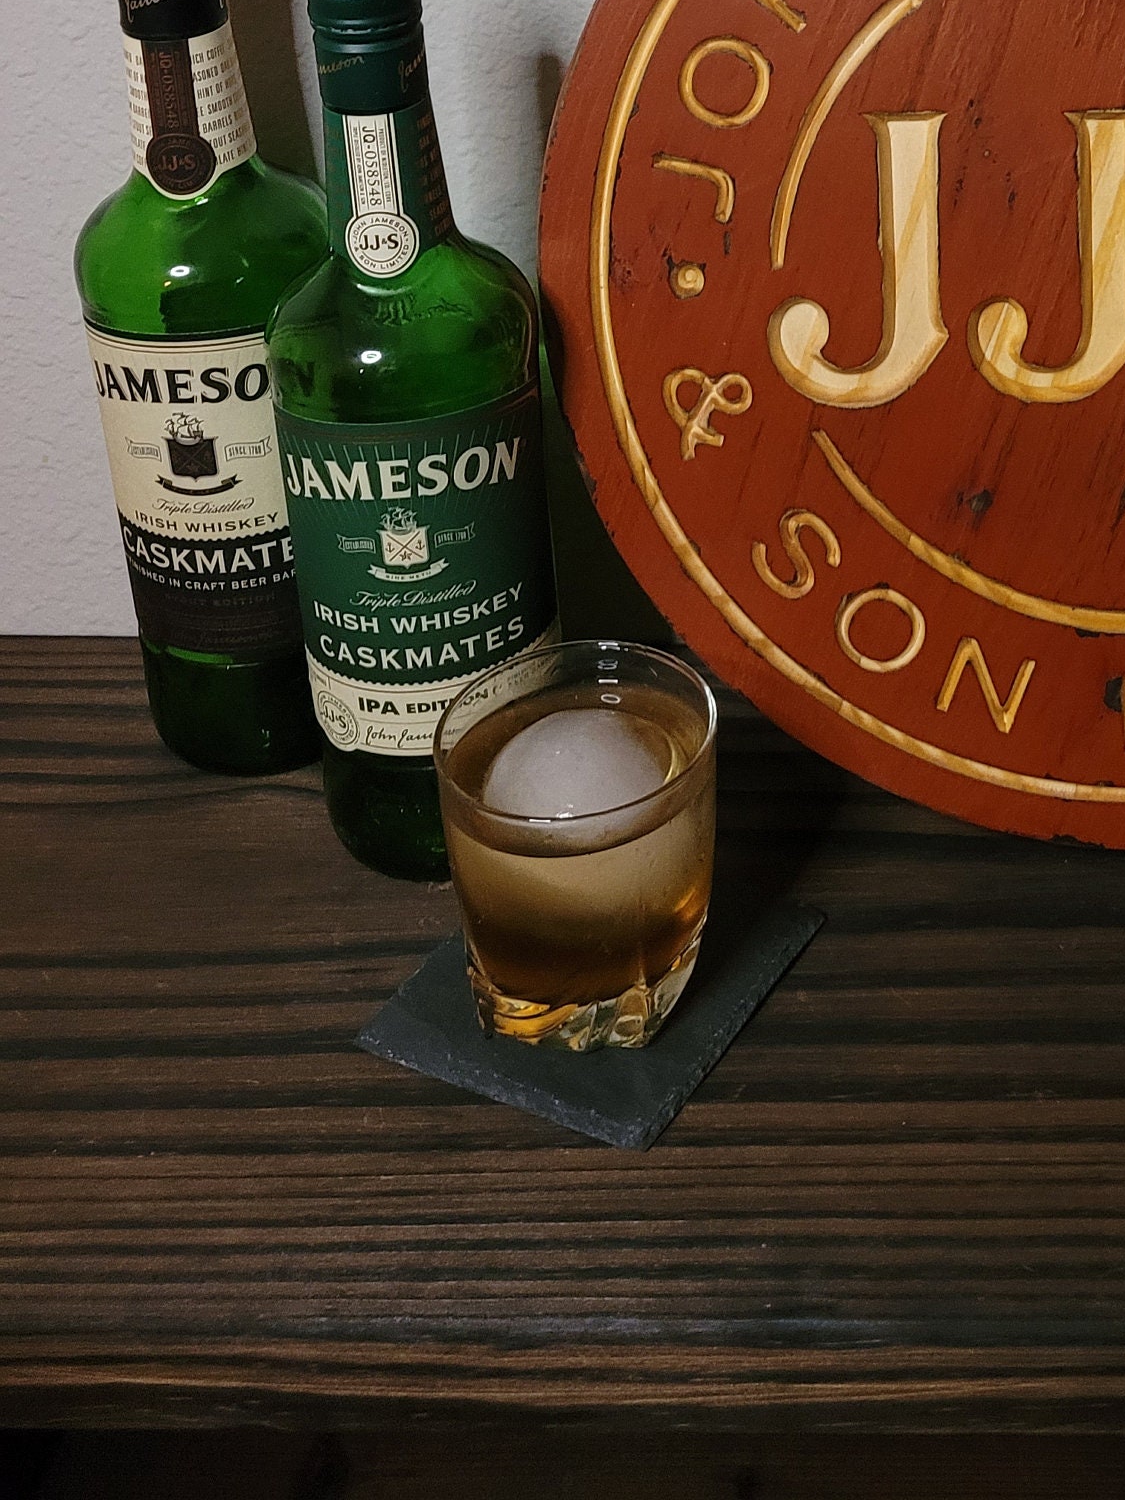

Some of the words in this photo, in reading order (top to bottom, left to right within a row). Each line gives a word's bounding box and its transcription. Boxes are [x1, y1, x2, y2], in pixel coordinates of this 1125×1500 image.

[202, 114, 233, 134] BARRELS
[216, 149, 236, 165] LATE
[362, 126, 382, 207] JQ-058548
[370, 216, 409, 238] JAMESON
[359, 233, 399, 251] JJ&S
[359, 254, 377, 269] SON
[380, 244, 410, 270] LIMITED
[94, 357, 272, 404] JAMESO
[286, 436, 521, 501] JAMESON
[152, 498, 192, 516] Triple
[192, 497, 255, 514] Distilled
[135, 509, 178, 531] IRISH
[184, 512, 280, 533] WHISKEY
[663, 368, 753, 461] &
[751, 507, 1036, 734] SON
[169, 577, 181, 588] IN
[185, 581, 226, 591] CRAFT
[231, 576, 268, 590] BEER
[350, 591, 401, 612] Triple
[401, 580, 477, 607] Distilled
[313, 600, 380, 634] IRISH
[390, 582, 523, 635] WHISKEY
[320, 616, 525, 670] CASKMATES
[358, 696, 400, 715] IPA
[365, 725, 397, 746] John
